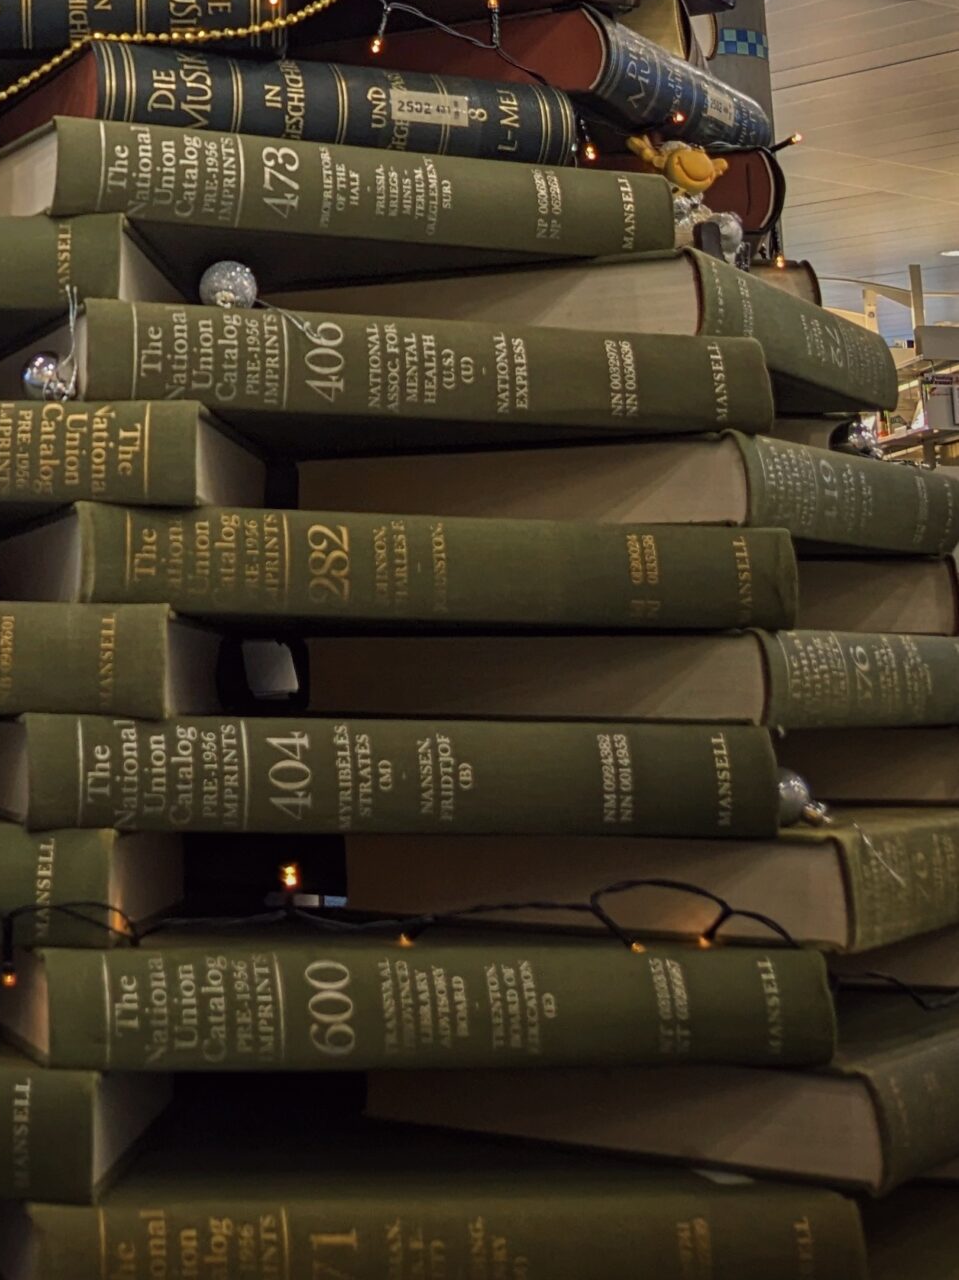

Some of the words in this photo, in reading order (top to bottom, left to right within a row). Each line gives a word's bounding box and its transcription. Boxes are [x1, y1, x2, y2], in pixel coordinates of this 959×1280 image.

[148, 69, 177, 112] DIE
[180, 52, 212, 128] MUSIK
[265, 84, 282, 109] IN
[367, 86, 387, 128] UND
[397, 100, 431, 115] 2502
[468, 108, 487, 121] 8
[106, 144, 129, 193] The
[128, 126, 152, 217] National
[153, 140, 176, 206] Union
[175, 134, 202, 218] Catalog
[203, 141, 219, 213] PRE-1956
[218, 137, 236, 221] IMPRINTS
[262, 146, 300, 219] 473
[335, 163, 346, 191] THE
[336, 192, 346, 211] OF
[349, 170, 360, 206] HALF
[537, 220, 548, 239] NP
[618, 176, 635, 250] MANSELL
[141, 325, 163, 378] The
[192, 319, 214, 390] Union
[215, 314, 241, 402] Catalog
[245, 318, 261, 396] PRE-1956
[263, 313, 279, 404] IMPRINTS
[304, 321, 345, 403] 406
[366, 323, 382, 410] NATIONAL
[385, 323, 399, 354] FOR
[404, 332, 418, 404] MENTAL
[422, 334, 436, 405] HEALTH
[460, 356, 475, 384] (U)
[493, 332, 510, 414] NATIONAL
[511, 337, 528, 410] EXPRESS
[386, 356, 399, 413] ASSOC.
[611, 396, 622, 417] NN
[626, 396, 638, 417] NN
[708, 341, 728, 422] MANSELL
[32, 403, 64, 495] Catalog
[64, 412, 89, 487] Union
[118, 423, 141, 478] The
[133, 527, 157, 584] The
[307, 524, 350, 603] 282
[87, 744, 111, 802] The
[113, 720, 138, 830] National
[144, 734, 166, 816] Union
[168, 725, 197, 825] Catalog
[200, 731, 217, 818] PRE-1956
[220, 724, 238, 826] IMPRINTS
[265, 730, 312, 821] 404
[379, 760, 392, 792] (M)
[436, 734, 455, 820] FRIDTJOF
[458, 761, 474, 790] (B)
[711, 732, 730, 827] MANSELL
[115, 974, 139, 1037] The
[174, 964, 198, 1051] Union
[202, 956, 227, 1063] Catalog
[304, 960, 356, 1055] 600
[414, 969, 432, 1043] LIBRARY
[432, 965, 451, 1049] ADVISORY
[452, 975, 469, 1037] BOARD
[500, 964, 515, 986] OF
[756, 956, 783, 1055] MANSELL
[504, 989, 522, 1049] BOARD
[12, 1077, 33, 1189] MANSELL
